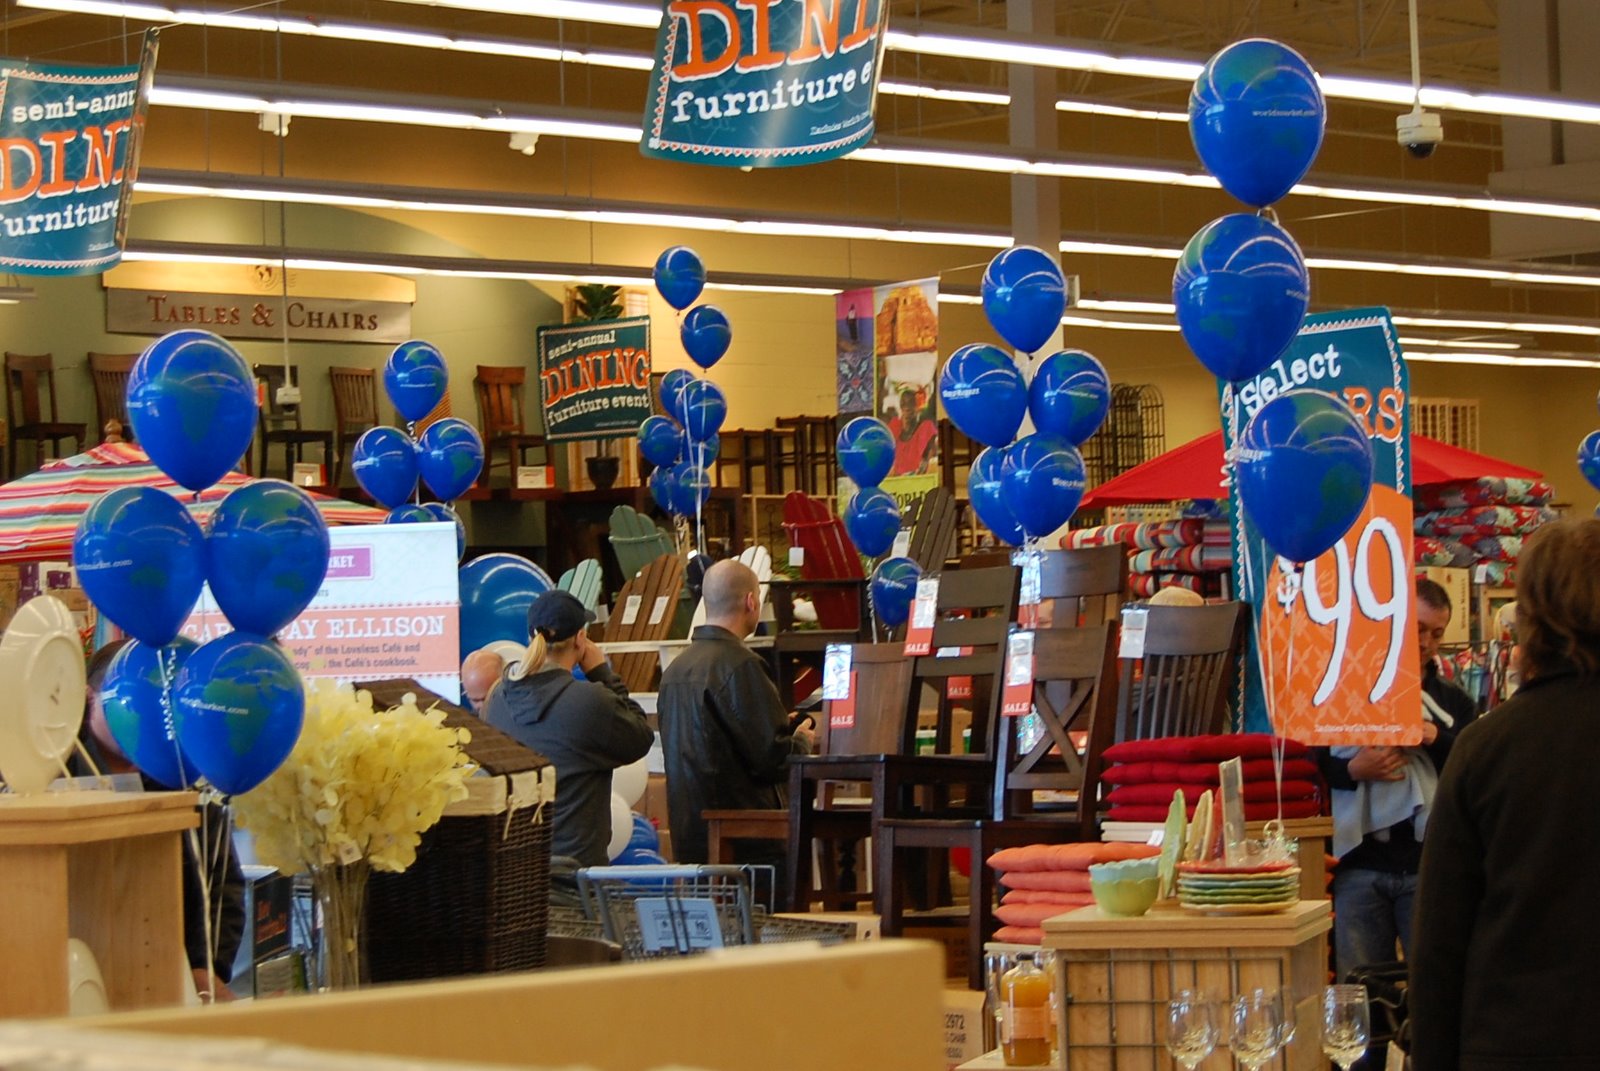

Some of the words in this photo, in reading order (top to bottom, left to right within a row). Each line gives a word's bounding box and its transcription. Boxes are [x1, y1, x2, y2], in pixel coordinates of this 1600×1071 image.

[667, 0, 878, 82] DINI
[671, 66, 857, 123] furniture
[0, 118, 132, 205] DIN
[147, 295, 241, 325] TABLES
[252, 302, 275, 328] &
[286, 302, 379, 331] CHAIRS
[548, 330, 616, 360] semi-annual
[540, 347, 652, 409] DINING
[1239, 343, 1341, 417] Select
[548, 398, 609, 426] furniture
[611, 394, 650, 408] event
[1332, 387, 1405, 443] RS
[326, 615, 446, 640] ELLISON
[325, 645, 339, 655] the
[341, 644, 380, 655] Loveless
[904, 643, 930, 654] SALE
[949, 686, 972, 697] SALE
[831, 714, 854, 726] SALE
[1003, 702, 1030, 714] SALE
